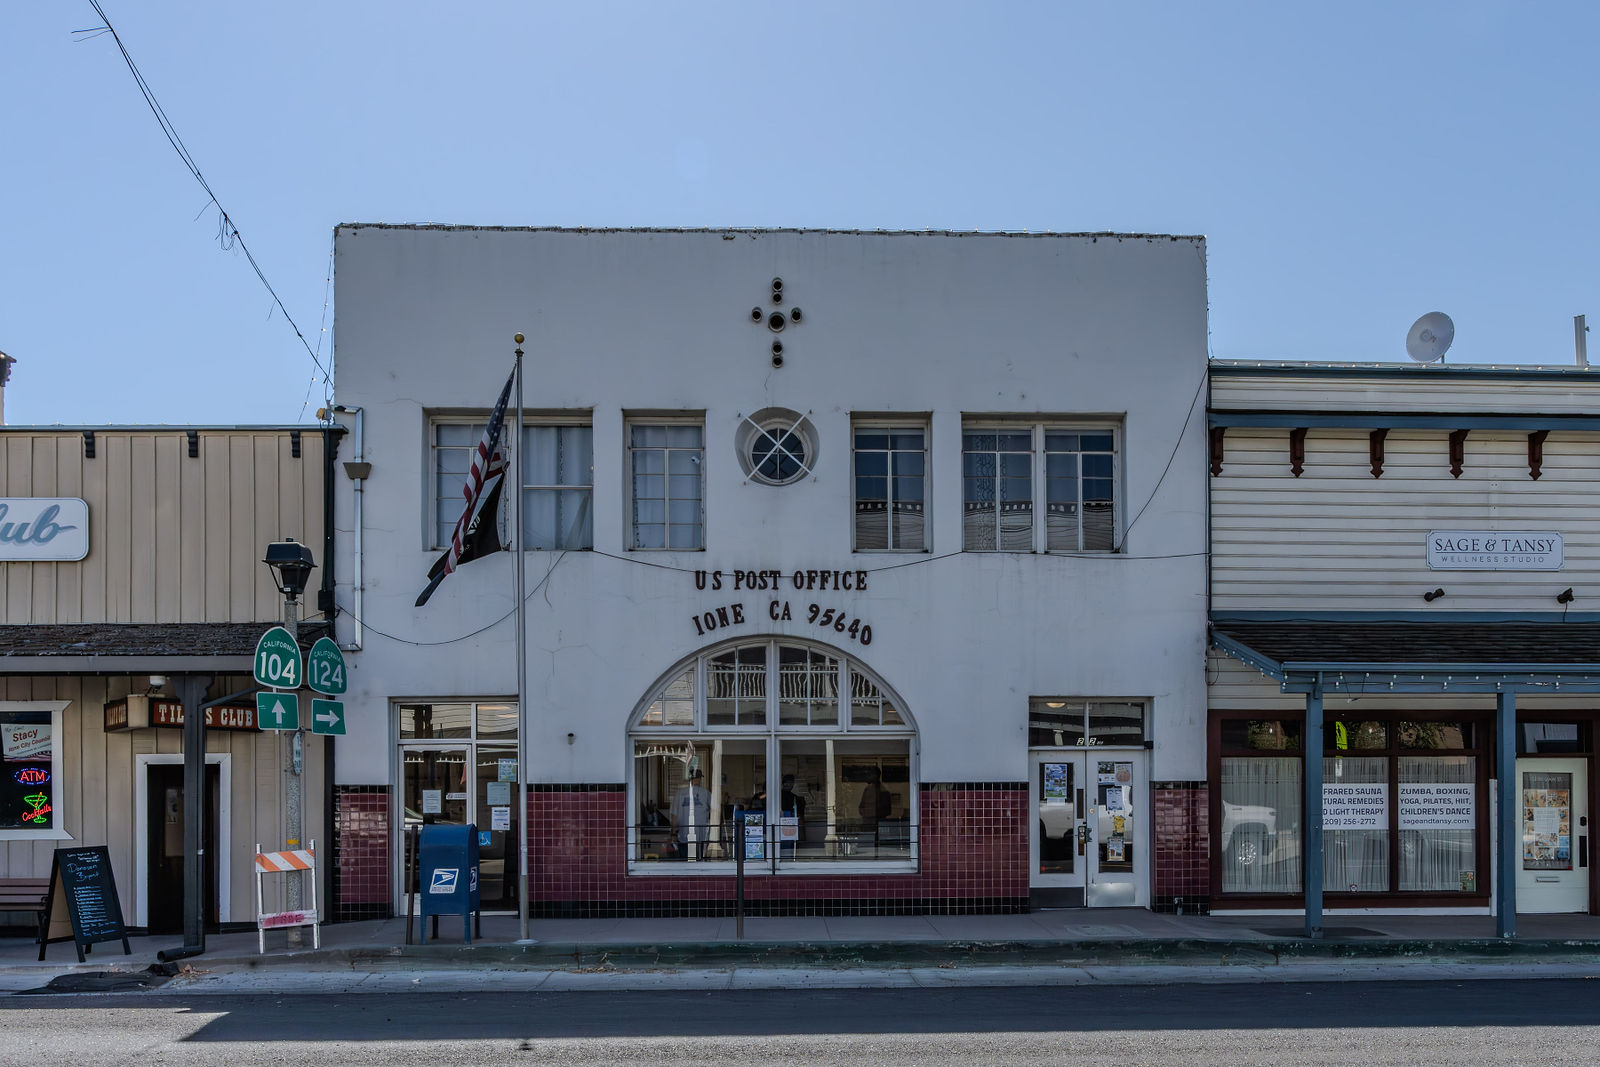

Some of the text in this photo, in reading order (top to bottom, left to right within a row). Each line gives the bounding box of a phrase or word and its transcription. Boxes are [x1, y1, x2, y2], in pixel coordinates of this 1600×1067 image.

[1434, 538, 1556, 552] SAGE & TANSY
[734, 570, 781, 590] POST
[793, 570, 868, 591] OFFICE
[692, 600, 872, 646] IONE CA 95640
[263, 640, 296, 655] CALIFORNIA
[260, 651, 296, 685] 104
[312, 659, 343, 689] 124
[220, 708, 253, 727] CLUB
[12, 728, 39, 743] Stacy
[20, 770, 46, 782] ATM
[1323, 797, 1384, 805] TURAL REMEDIES
[22, 803, 52, 821] Cocktails
[1350, 808, 1384, 816] THERAPY
